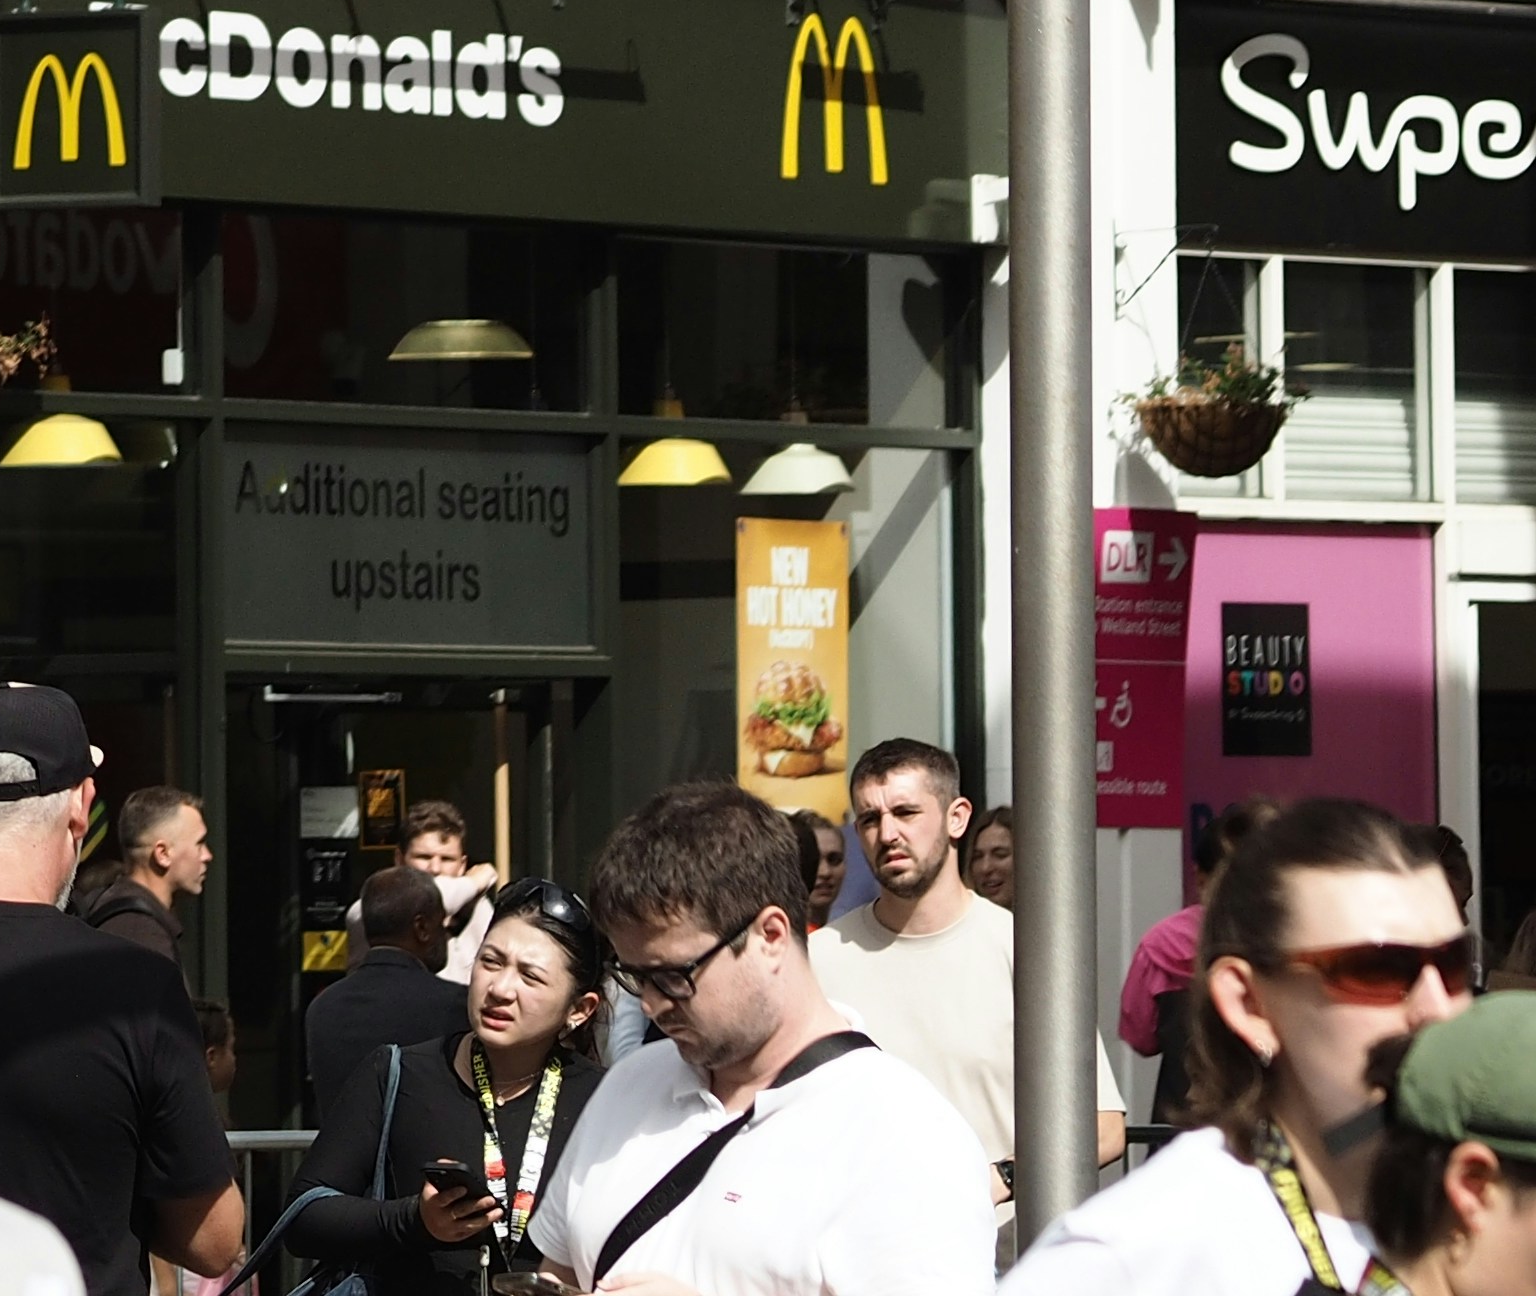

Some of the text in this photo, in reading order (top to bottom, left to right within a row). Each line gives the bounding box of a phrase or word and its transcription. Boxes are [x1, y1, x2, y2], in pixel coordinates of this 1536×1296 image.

[158, 10, 565, 128] cDonald's
[235, 459, 571, 538] Additional seating
[770, 546, 810, 586] NEW
[1106, 542, 1148, 573] DLR
[331, 549, 481, 614] upstairs
[746, 586, 838, 628] HOT HONEY
[1225, 634, 1306, 667] BEAUTY
[1136, 779, 1168, 796] route
